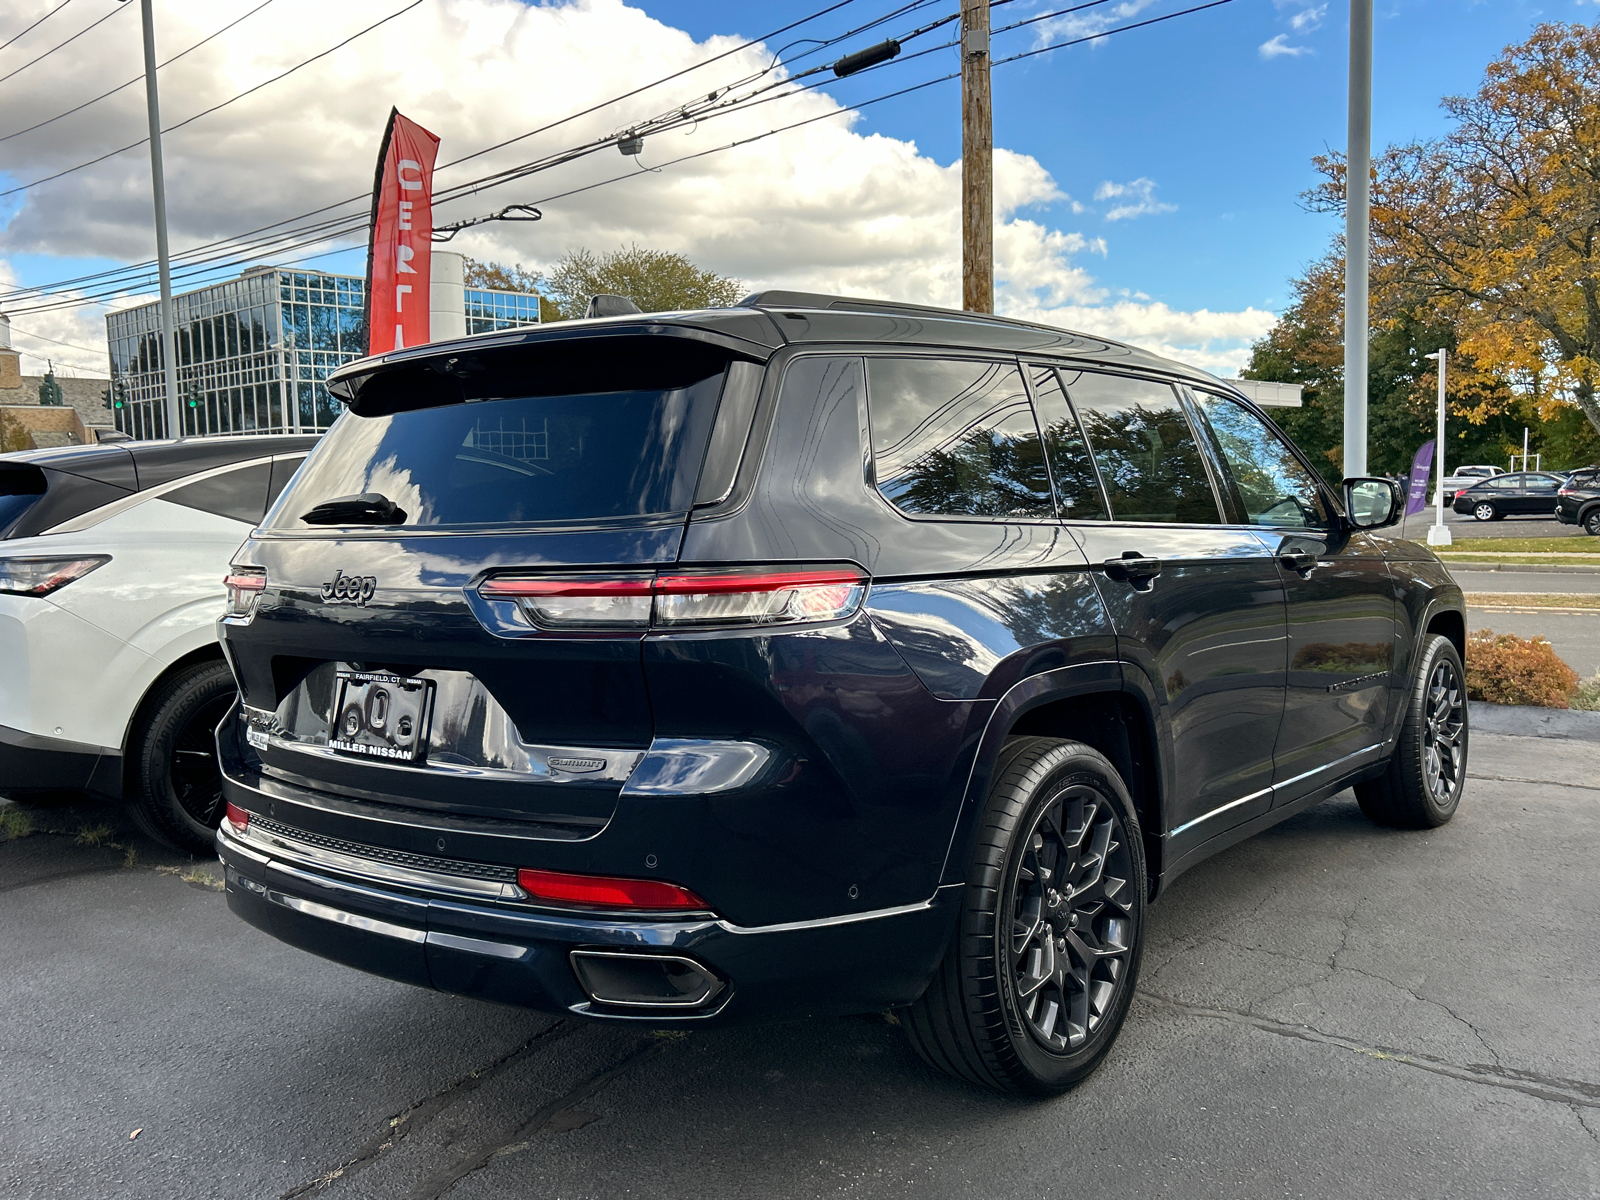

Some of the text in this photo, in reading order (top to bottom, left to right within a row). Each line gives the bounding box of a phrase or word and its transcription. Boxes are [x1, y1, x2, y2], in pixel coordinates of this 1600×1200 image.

[321, 569, 376, 609] Jeep
[355, 673, 390, 683] FAIRFIELD,
[155, 676, 223, 750] BRIDGESTONE
[328, 739, 412, 760] MILLER NISSAN
[550, 759, 602, 768] SUMMIT
